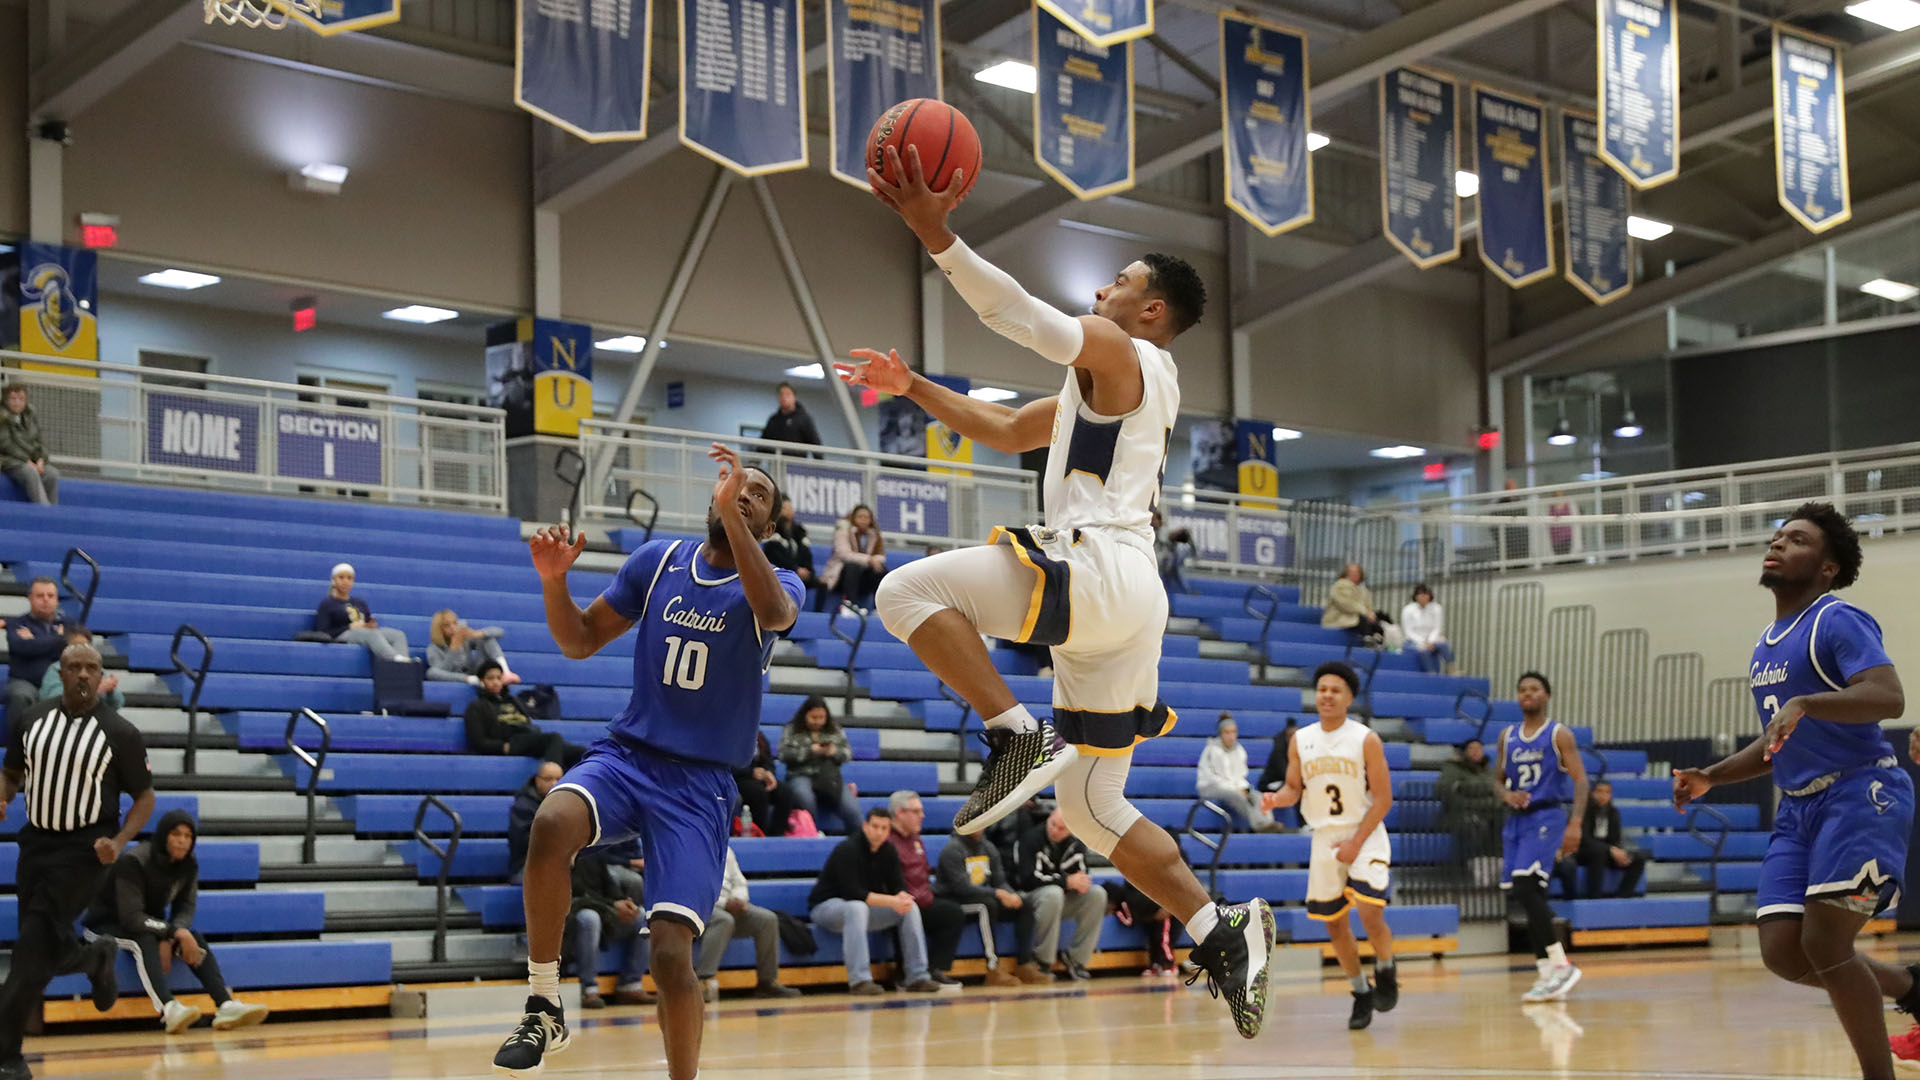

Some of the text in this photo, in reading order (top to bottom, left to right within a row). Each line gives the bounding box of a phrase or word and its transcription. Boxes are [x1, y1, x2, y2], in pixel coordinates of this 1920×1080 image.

[550, 336, 576, 370] N
[552, 376, 576, 409] U
[163, 408, 241, 461] HOME
[279, 414, 378, 442] SECTION
[1249, 433, 1266, 459] N
[877, 479, 946, 501] SECTION
[1250, 465, 1266, 492] U
[900, 501, 925, 533] H
[1255, 536, 1276, 564] G
[663, 595, 726, 633] Cabrini
[663, 636, 709, 691] 10
[1750, 660, 1788, 688] Cabrini
[1518, 763, 1542, 788] 21
[1326, 784, 1344, 816] 3
